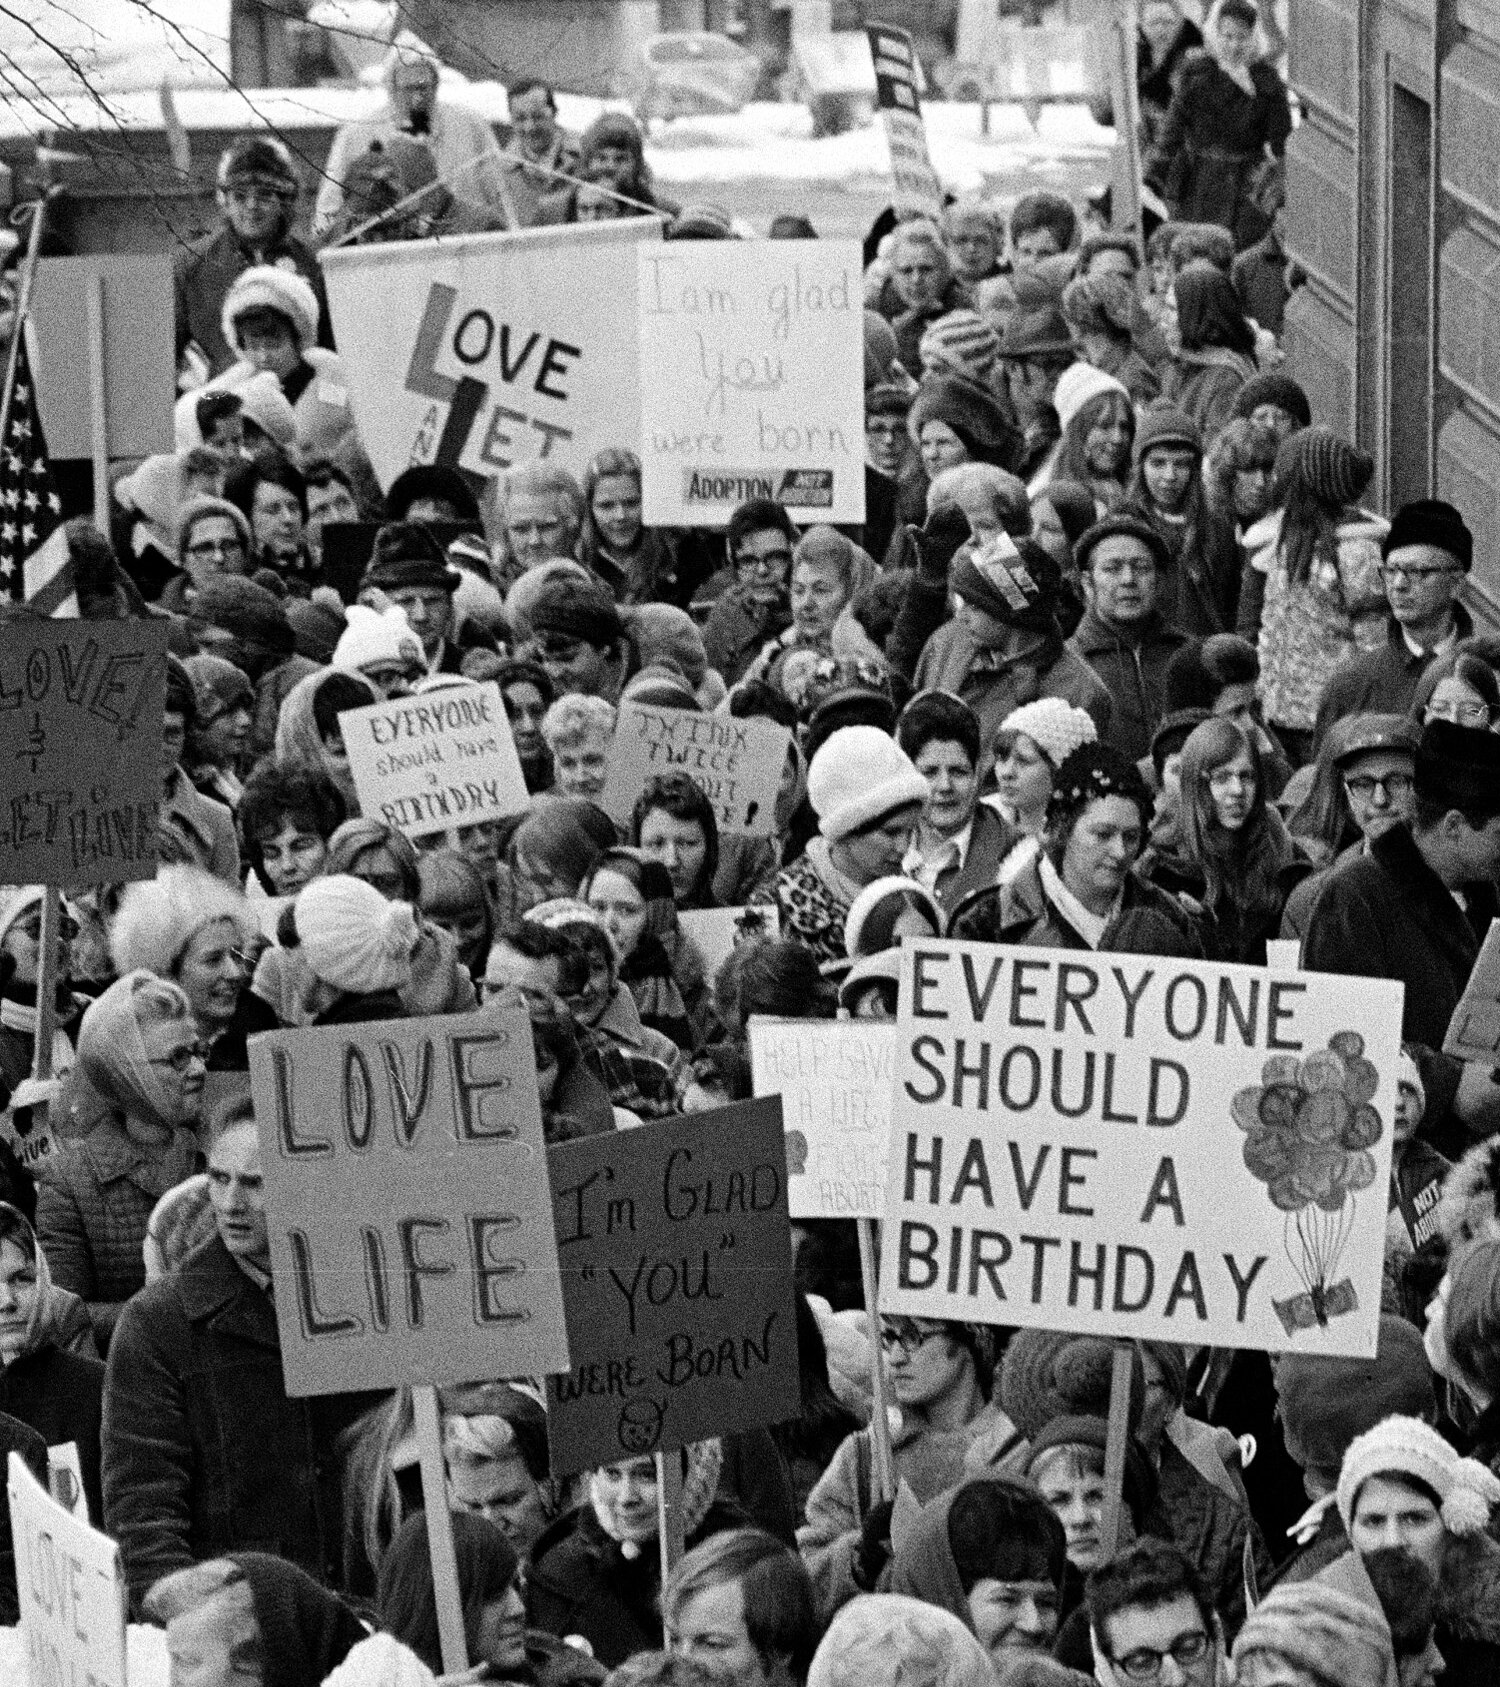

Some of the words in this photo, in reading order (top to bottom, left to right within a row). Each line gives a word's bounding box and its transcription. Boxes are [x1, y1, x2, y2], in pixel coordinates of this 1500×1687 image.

[404, 281, 582, 402] LOVE
[646, 256, 676, 315] I
[683, 287, 733, 314] am
[768, 266, 852, 339] glad
[695, 329, 784, 415] You
[651, 430, 728, 455] were
[758, 409, 850, 455] born
[688, 471, 774, 501] ADOPTION
[369, 693, 493, 745] EVERYONE
[376, 740, 445, 777] should
[380, 779, 500, 830] BIRTHDAY
[911, 949, 1308, 1052] EVERYONE
[270, 1027, 521, 1160] LOVE
[903, 1034, 1190, 1128] SHOULD
[556, 1164, 638, 1247] I'm
[663, 1146, 781, 1222] GLAD
[903, 1131, 1099, 1218] HAVE
[1140, 1155, 1187, 1227] A
[1412, 1179, 1440, 1217] NOT
[287, 1212, 531, 1342] LIFE
[899, 1218, 1268, 1325] BIRTHDAY
[553, 1357, 647, 1400] WERE
[655, 1310, 779, 1388] BORN
